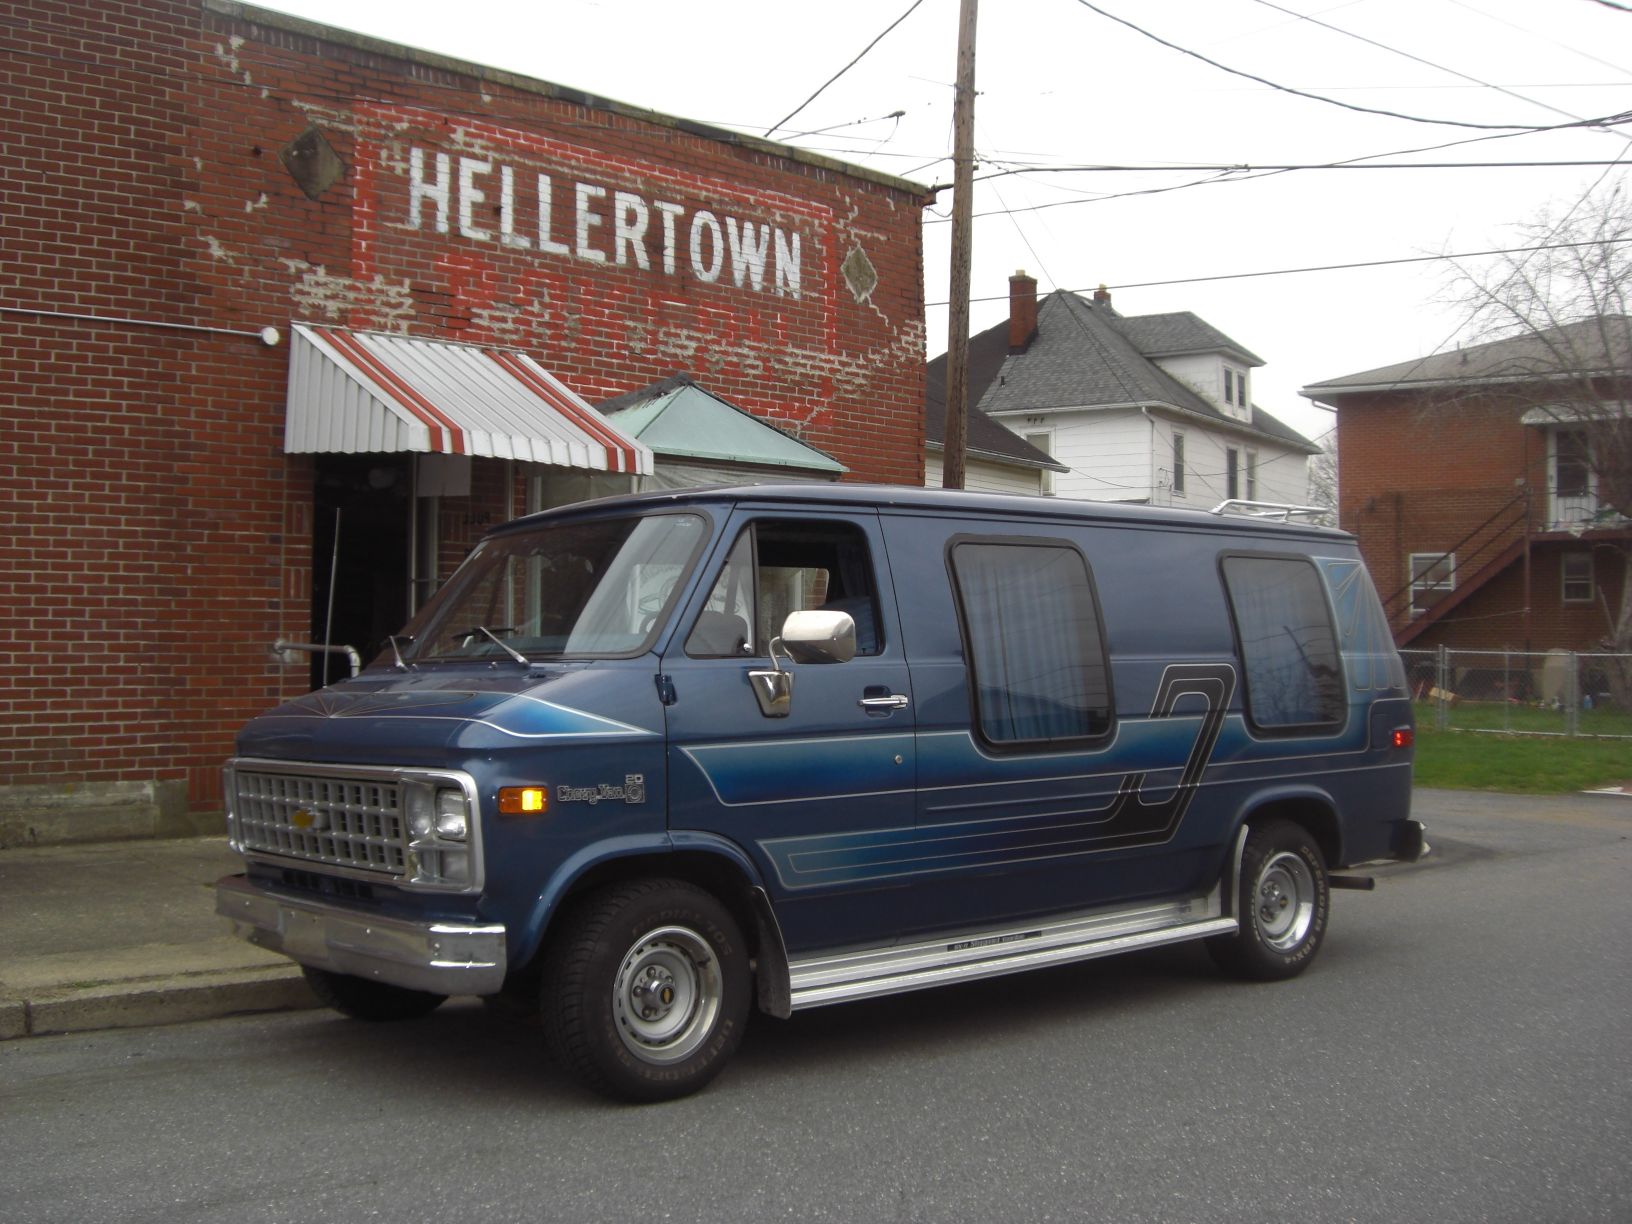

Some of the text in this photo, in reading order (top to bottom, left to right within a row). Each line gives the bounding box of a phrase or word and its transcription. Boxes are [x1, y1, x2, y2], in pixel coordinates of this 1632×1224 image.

[408, 146, 802, 300] HELLERTOWN
[625, 774, 644, 784] 20
[598, 784, 625, 800] Van
